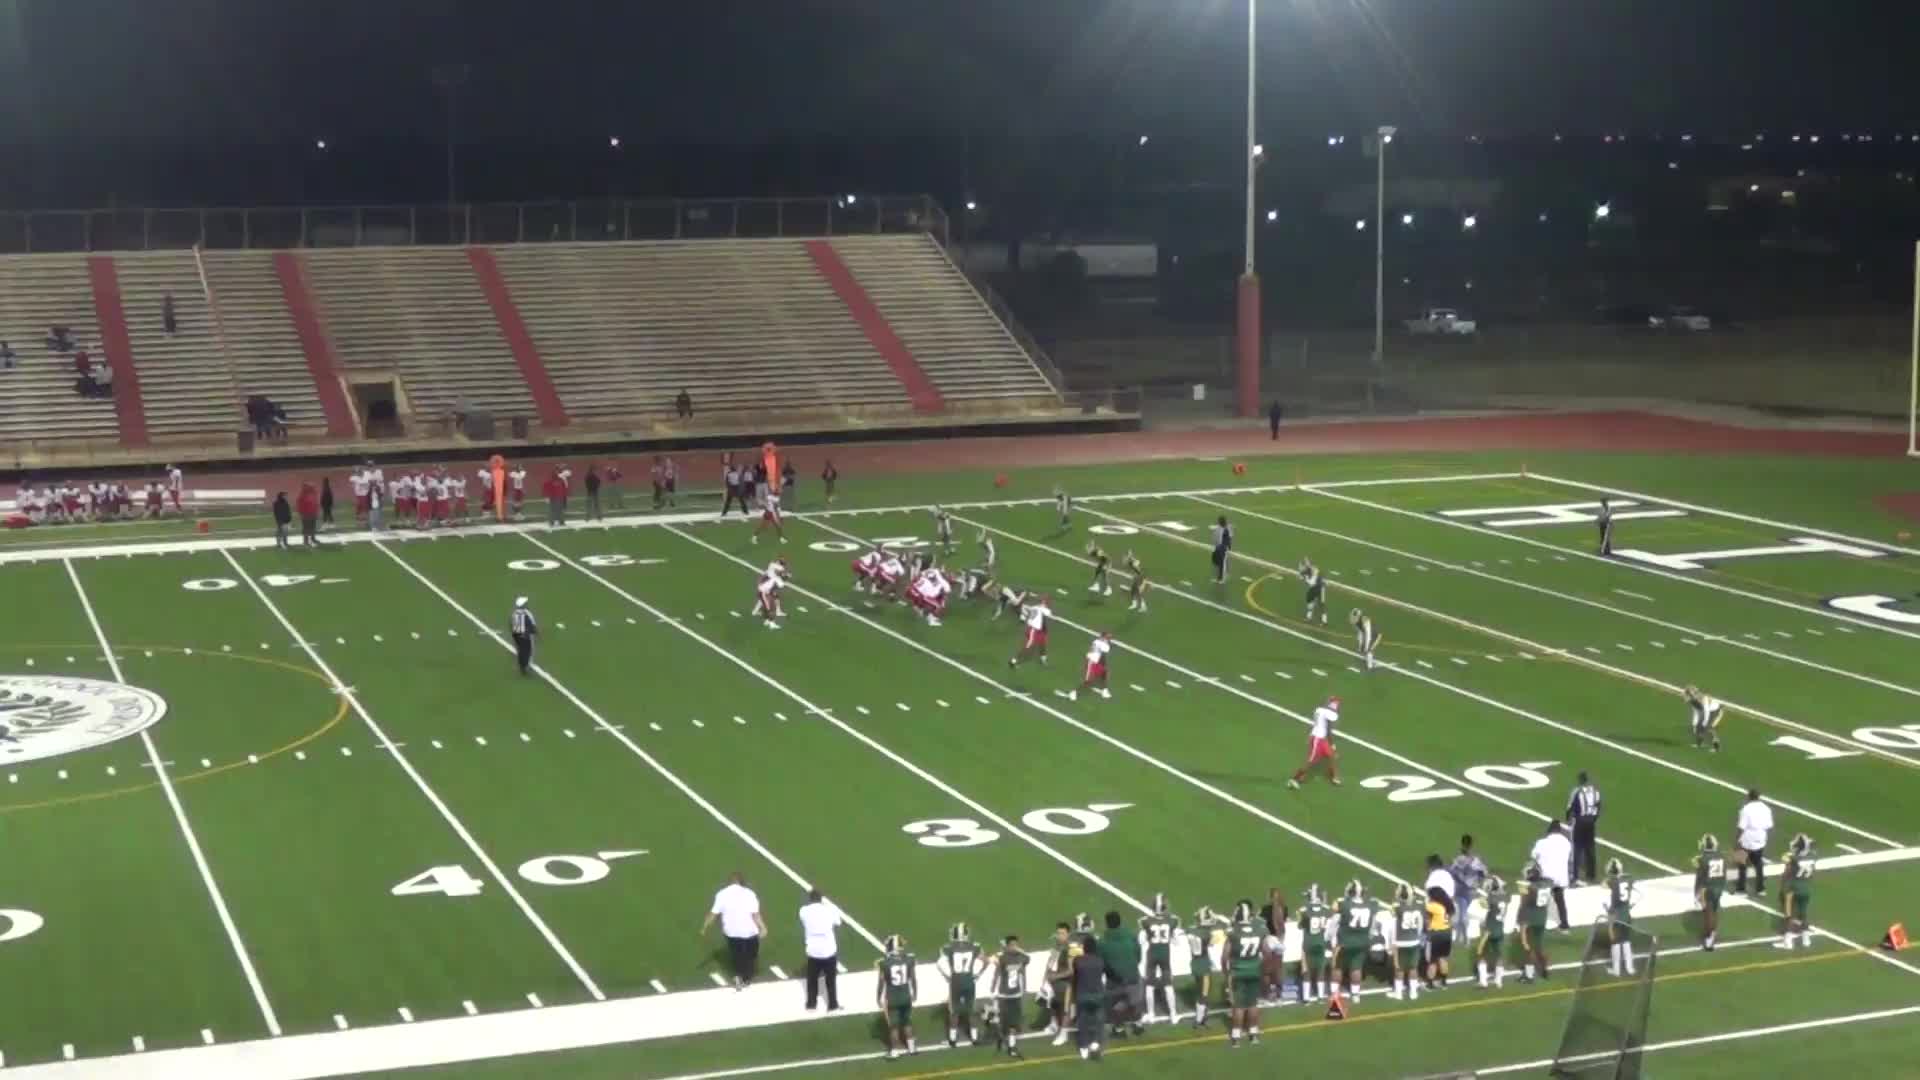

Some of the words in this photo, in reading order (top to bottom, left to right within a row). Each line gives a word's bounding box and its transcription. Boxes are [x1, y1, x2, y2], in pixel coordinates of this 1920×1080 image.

[507, 554, 636, 571] 30
[182, 574, 317, 591] 40
[1768, 727, 1920, 759] 10
[1359, 765, 1550, 801] 20
[901, 807, 1110, 847] 30
[391, 855, 611, 896] 40
[1150, 923, 1170, 944] 33
[1239, 936, 1261, 957] 77
[890, 964, 908, 987] 51
